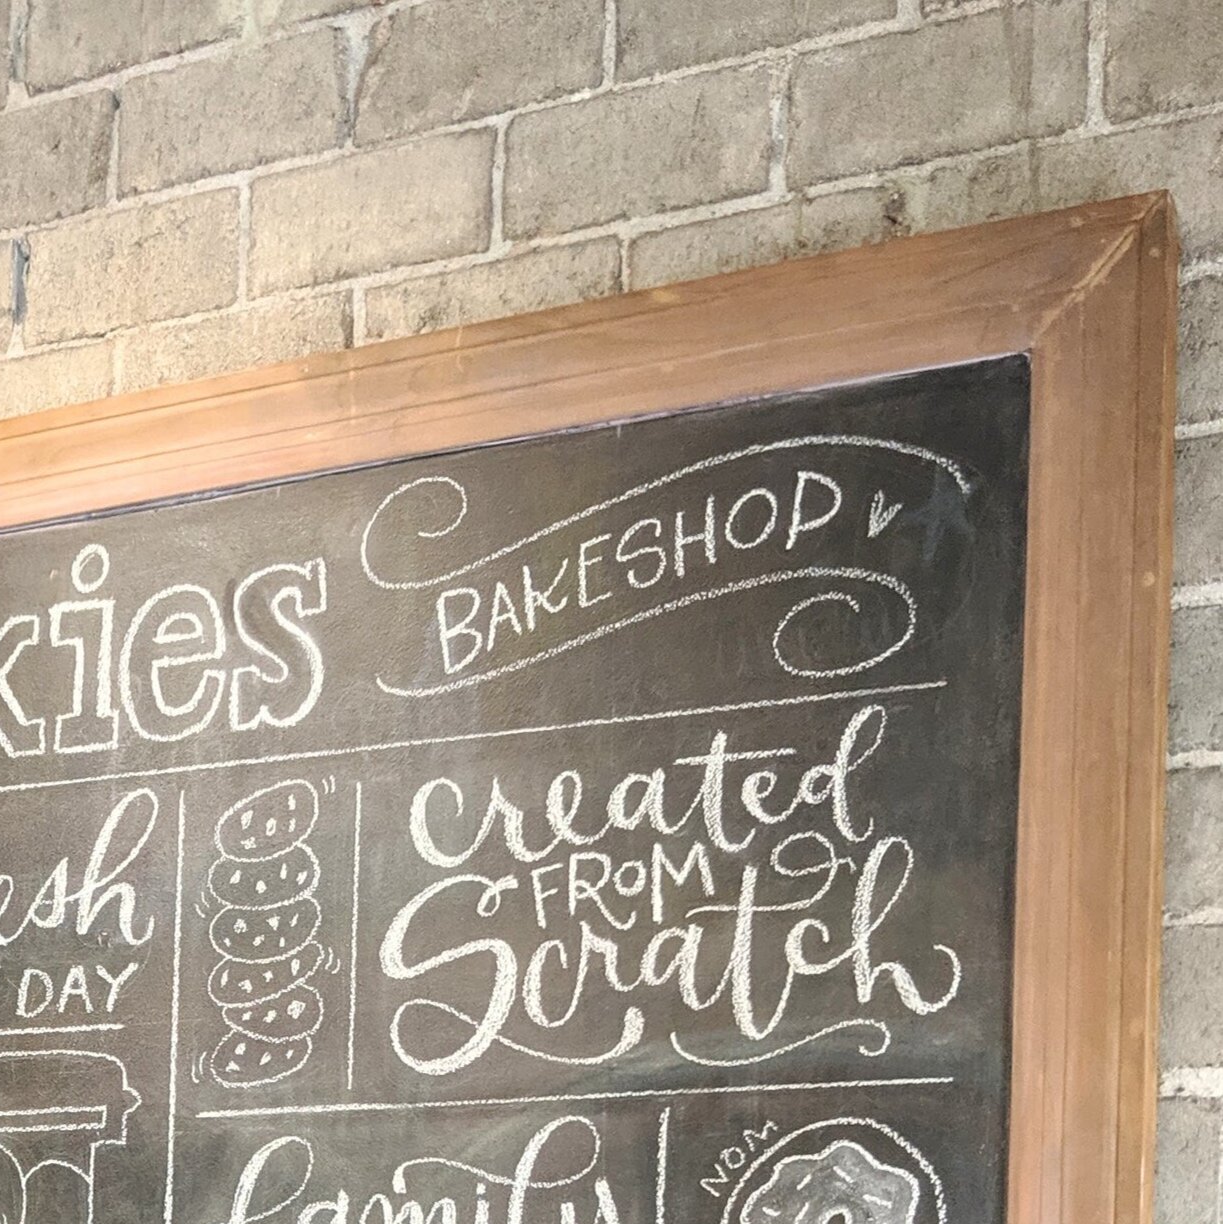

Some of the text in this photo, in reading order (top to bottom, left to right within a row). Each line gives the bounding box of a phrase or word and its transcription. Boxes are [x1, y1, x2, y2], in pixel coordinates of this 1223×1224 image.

[436, 471, 841, 674] BAKESHOP
[531, 841, 715, 931] FROM
[15, 962, 138, 1017] DAY
[379, 832, 962, 1076] Scratch
[700, 1120, 778, 1197] NOM
